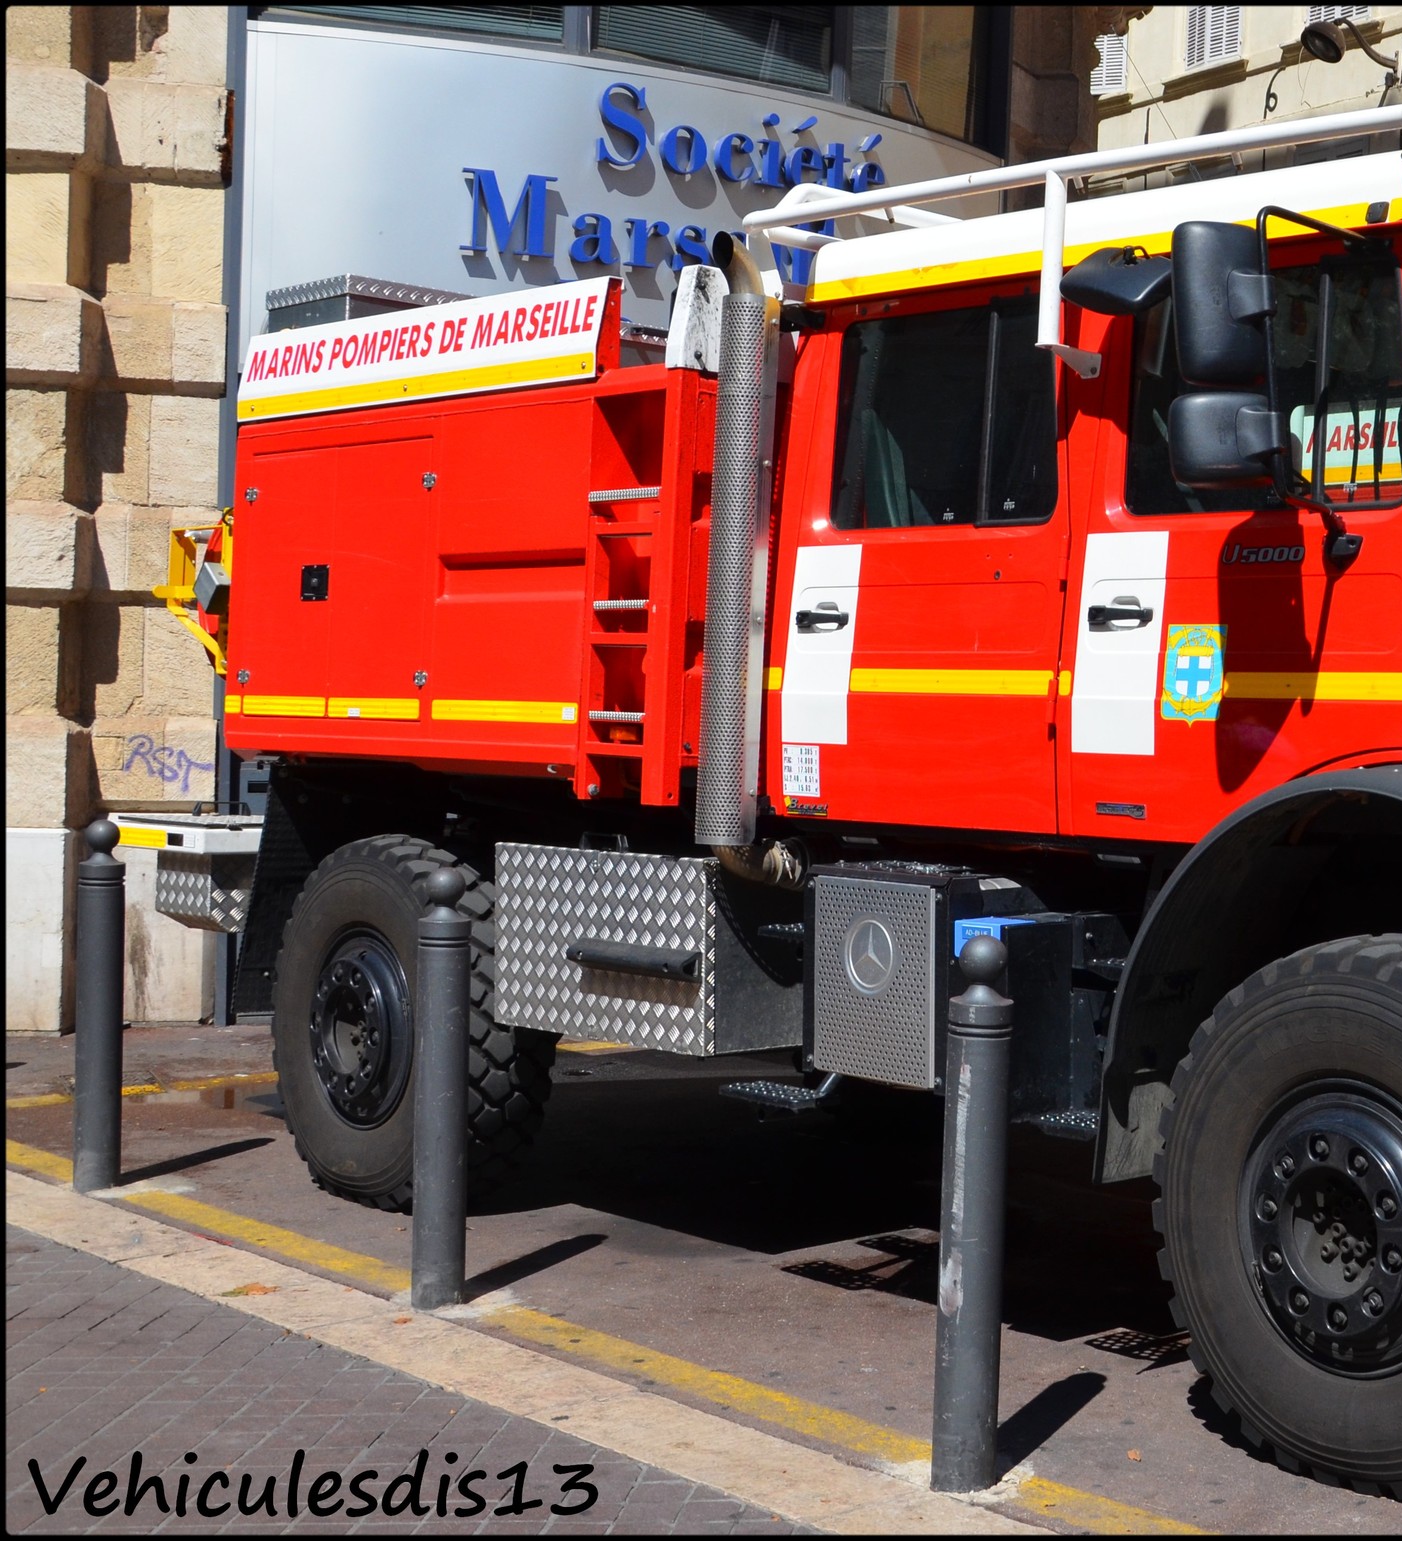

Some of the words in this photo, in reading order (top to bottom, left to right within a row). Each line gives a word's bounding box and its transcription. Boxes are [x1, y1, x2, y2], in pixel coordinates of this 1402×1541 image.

[597, 82, 886, 194] Société
[459, 167, 747, 271] Mars
[246, 339, 326, 382] MARINS
[328, 320, 435, 371] POMPIERS
[438, 317, 468, 355] DE
[470, 295, 598, 350] MARSEILLE
